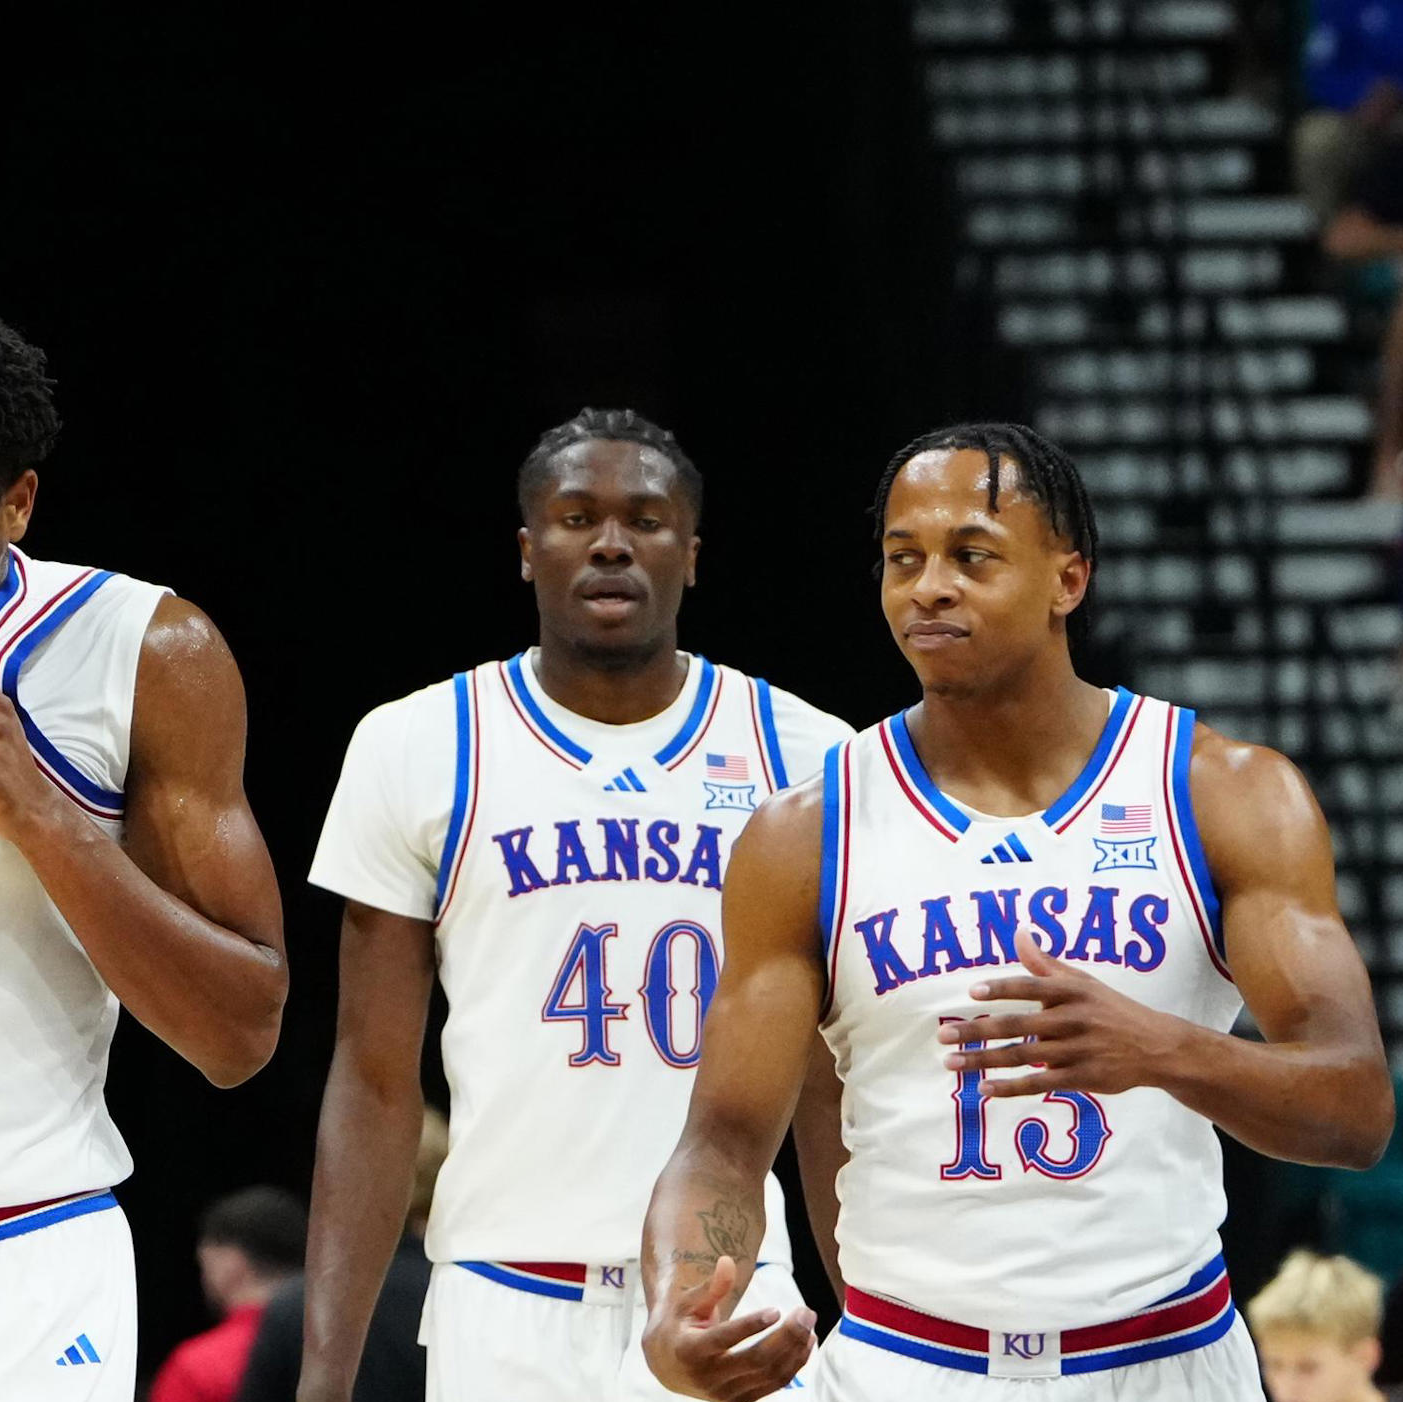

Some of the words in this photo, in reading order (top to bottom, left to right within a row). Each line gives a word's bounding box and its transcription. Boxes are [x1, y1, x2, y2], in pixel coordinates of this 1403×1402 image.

[492, 818, 722, 898] KANSA
[854, 885, 1170, 996] KANSAS
[542, 919, 721, 1069] 40
[1002, 1332, 1047, 1360] KU
